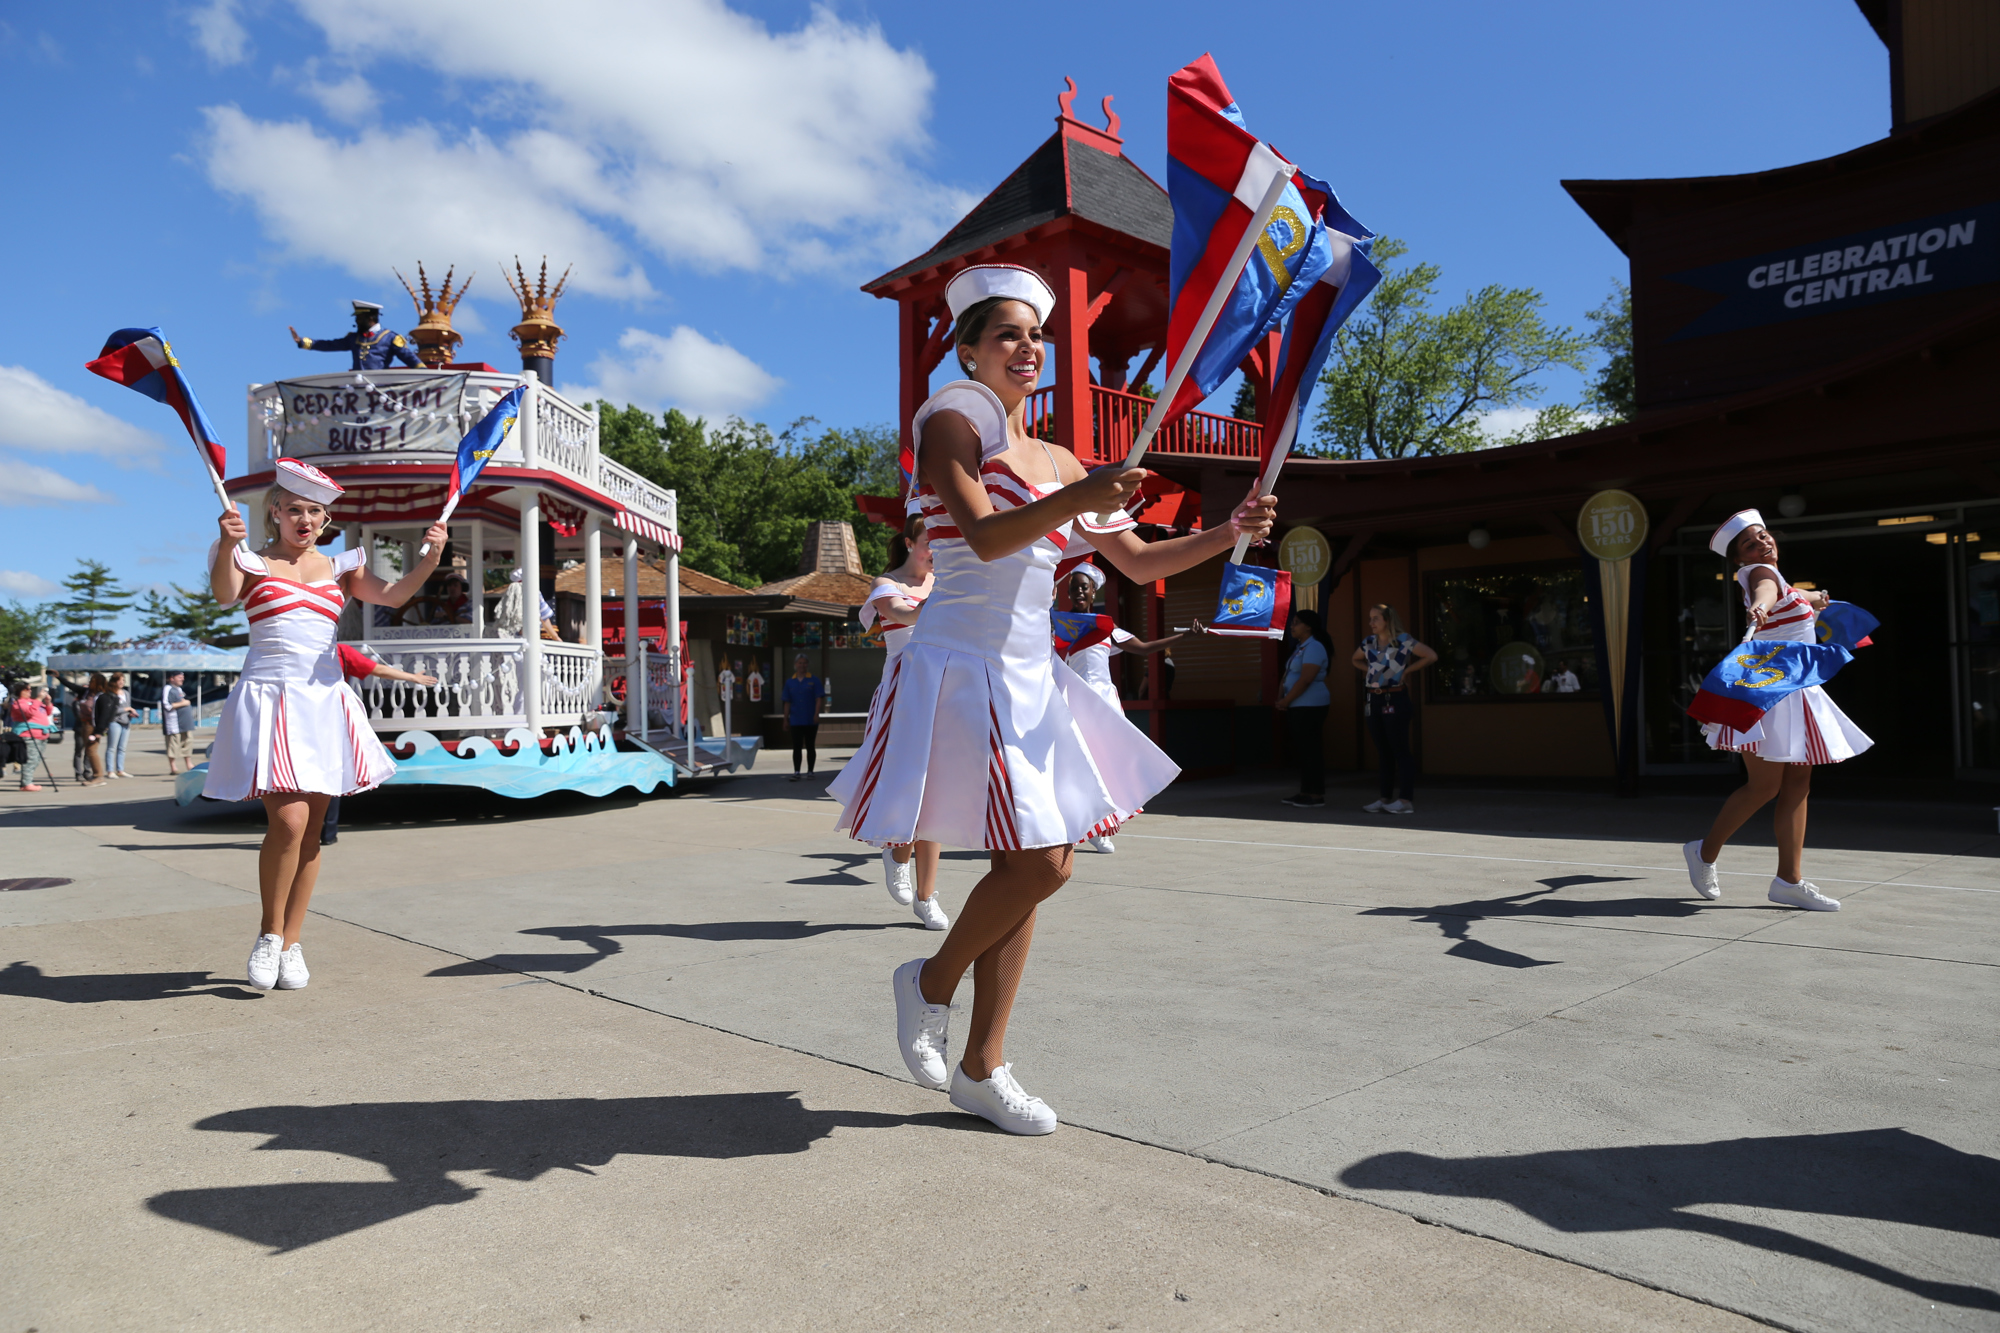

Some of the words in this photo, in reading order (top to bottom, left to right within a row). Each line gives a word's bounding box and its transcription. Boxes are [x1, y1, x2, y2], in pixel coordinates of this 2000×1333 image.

[1748, 220, 1976, 289] CELEBRATION
[1784, 259, 1933, 308] CENTRAL
[293, 392, 359, 415] CEDAR
[366, 386, 448, 414] POINT
[1589, 511, 1635, 537] 150
[1594, 535, 1632, 546] YEARS
[1288, 545, 1321, 566] 150
[1290, 564, 1319, 573] YEARS
